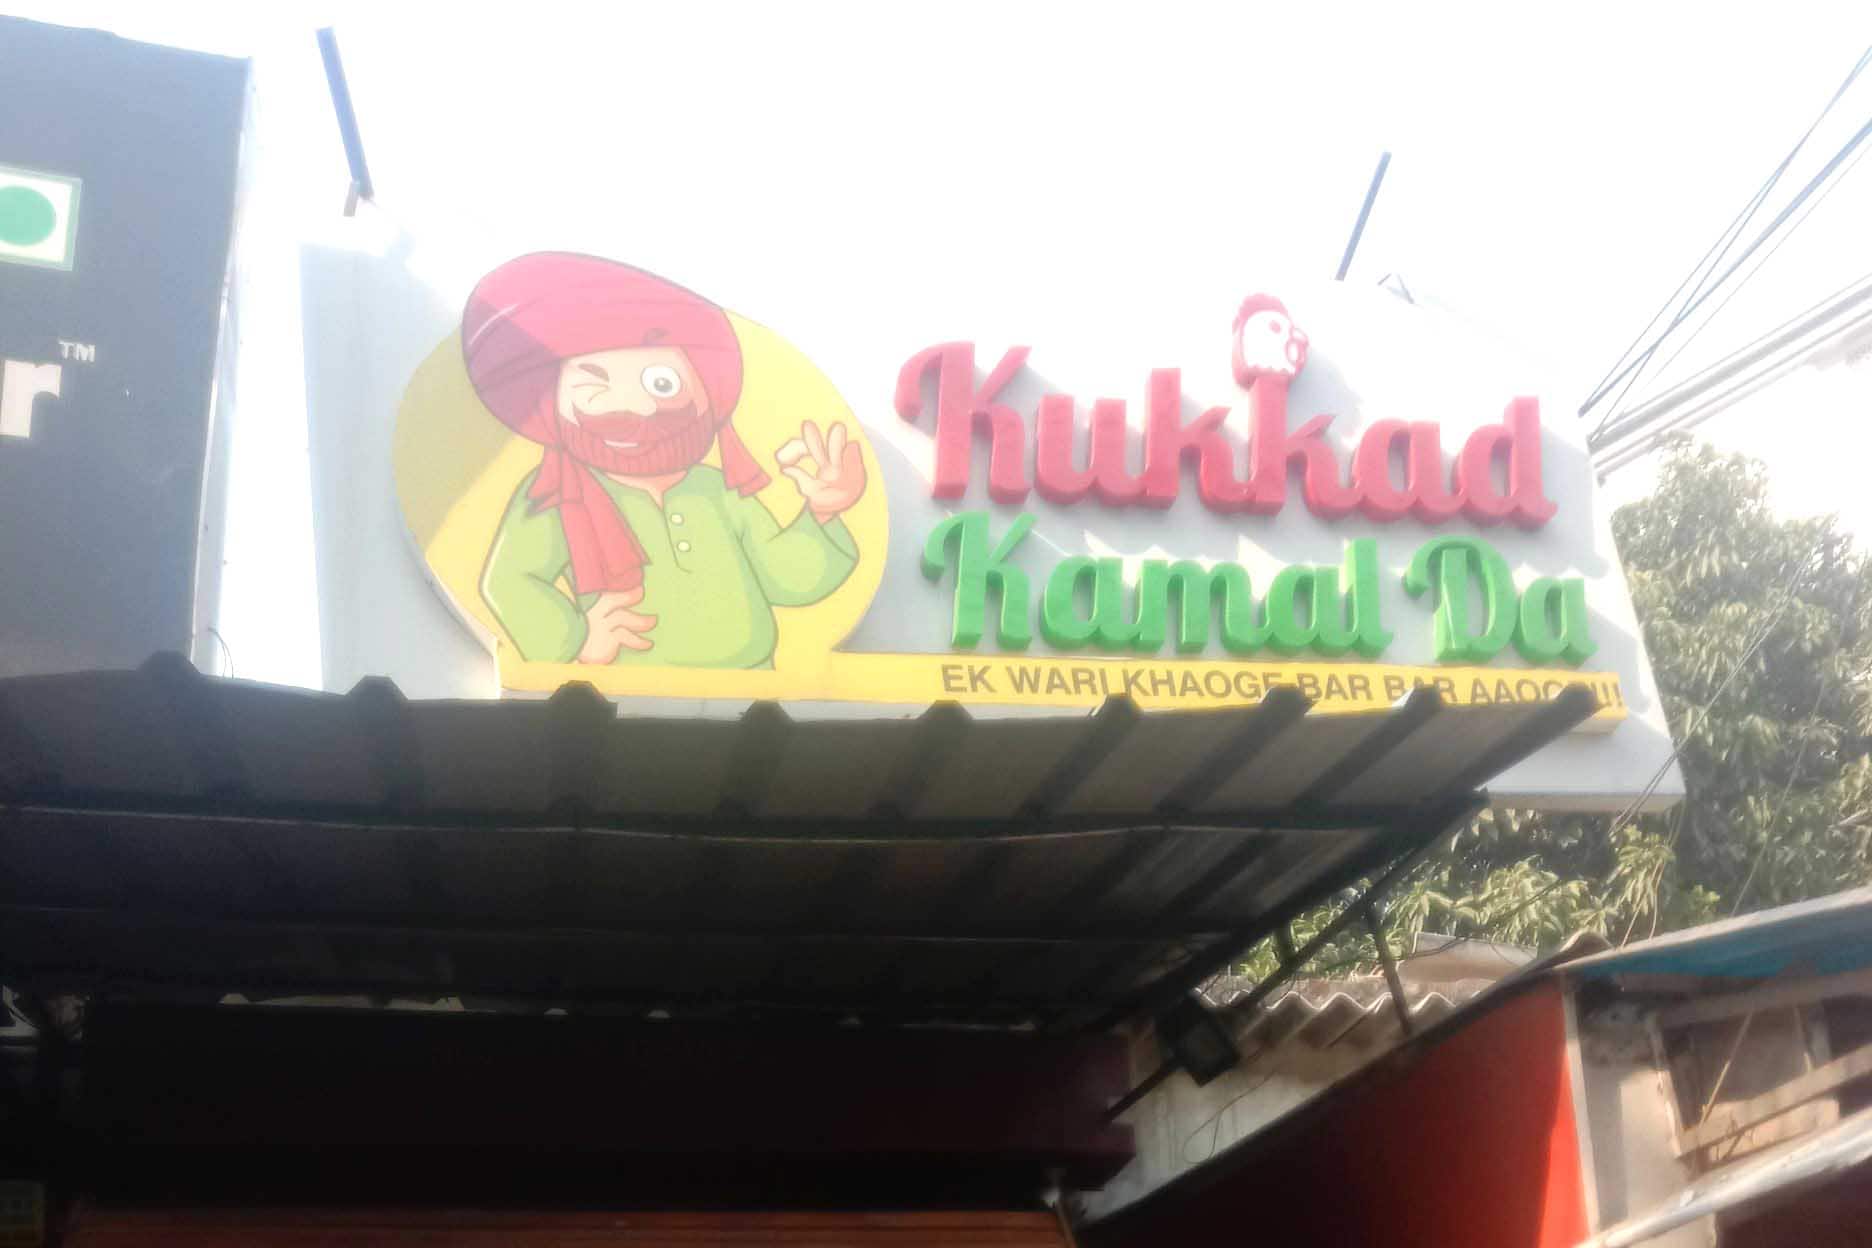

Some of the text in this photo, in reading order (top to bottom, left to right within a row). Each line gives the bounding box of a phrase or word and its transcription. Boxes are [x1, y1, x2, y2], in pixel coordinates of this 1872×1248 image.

[895, 341, 1557, 528] Kukkad
[920, 510, 1599, 666] Kamal Da
[941, 664, 996, 693] EK
[1005, 666, 1108, 697] WARI
[1296, 672, 1373, 701] BAR
